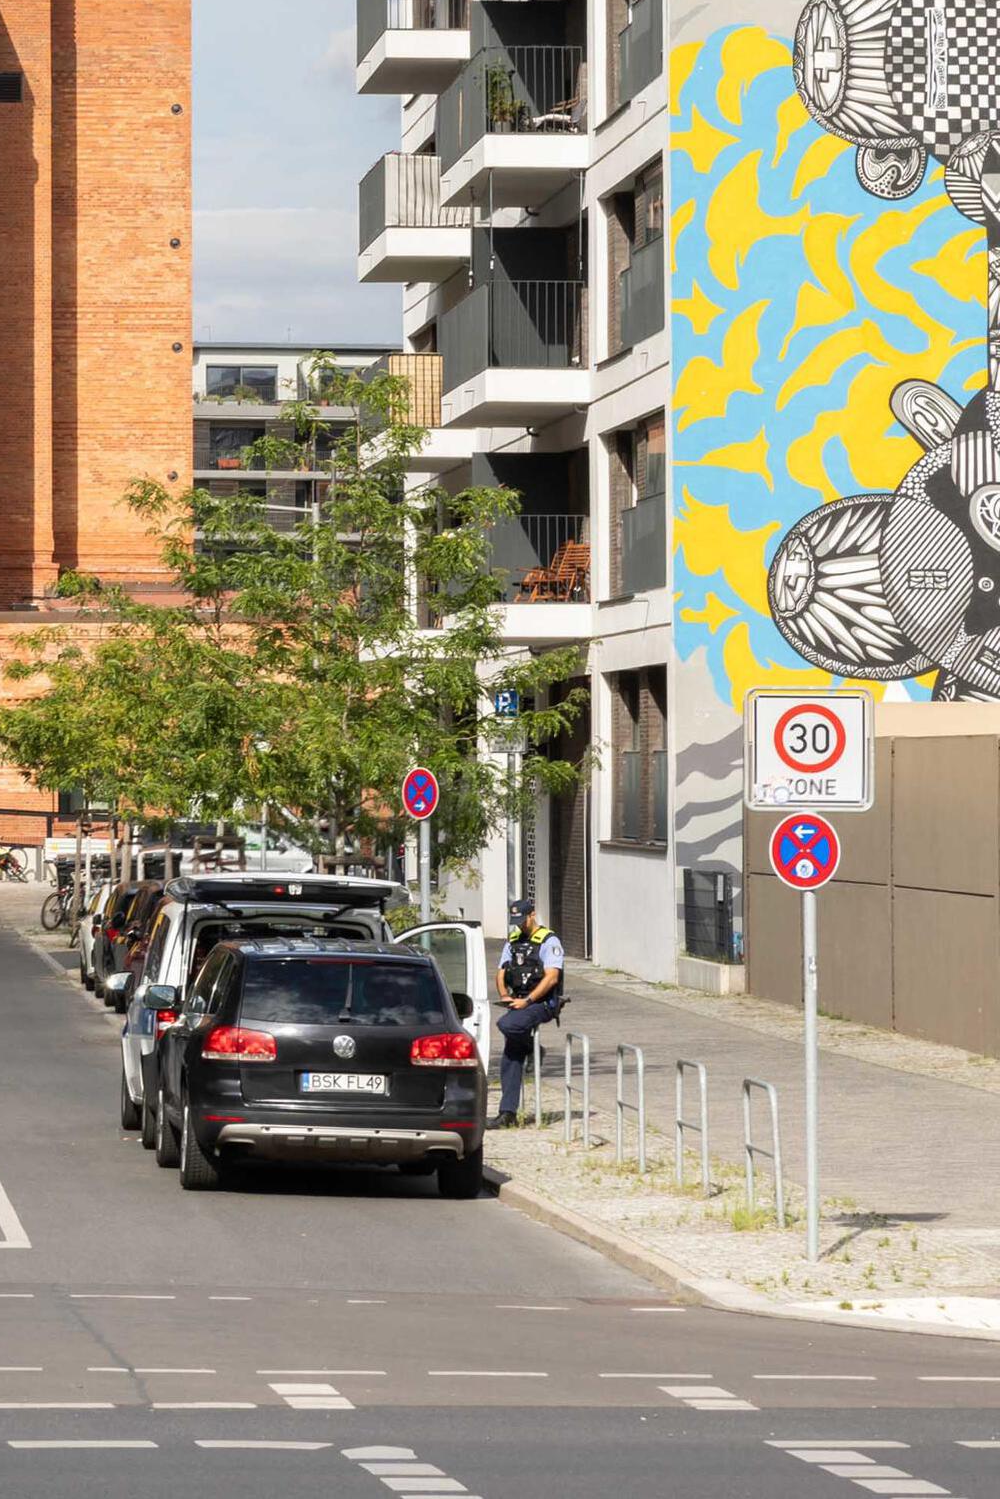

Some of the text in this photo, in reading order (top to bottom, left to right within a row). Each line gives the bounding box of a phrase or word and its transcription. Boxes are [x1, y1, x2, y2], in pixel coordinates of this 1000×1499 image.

[788, 723, 830, 754] 30
[311, 1074, 383, 1090] BSK FL49
